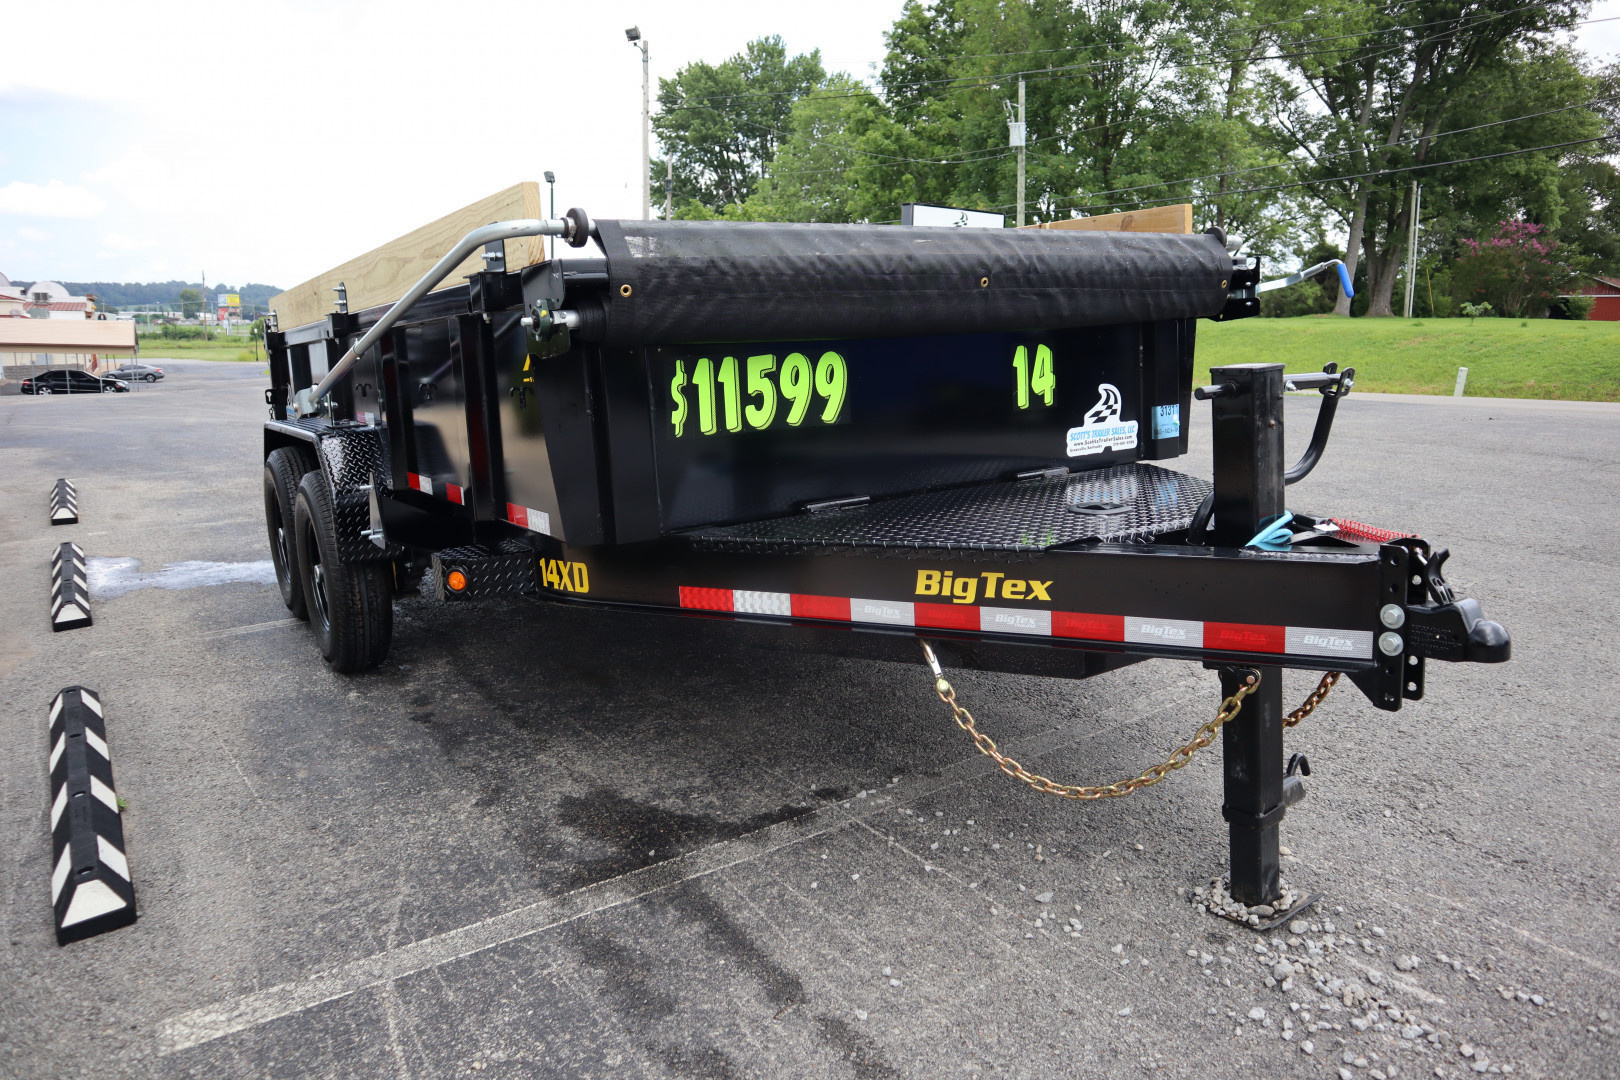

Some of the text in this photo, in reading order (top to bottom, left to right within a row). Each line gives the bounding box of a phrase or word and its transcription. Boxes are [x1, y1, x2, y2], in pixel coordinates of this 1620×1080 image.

[671, 351, 848, 438] $11599
[1012, 343, 1056, 410] 14
[1069, 431, 1091, 442] SCOTT'S
[1091, 428, 1111, 439] TRAILER
[539, 557, 590, 593] 14XD
